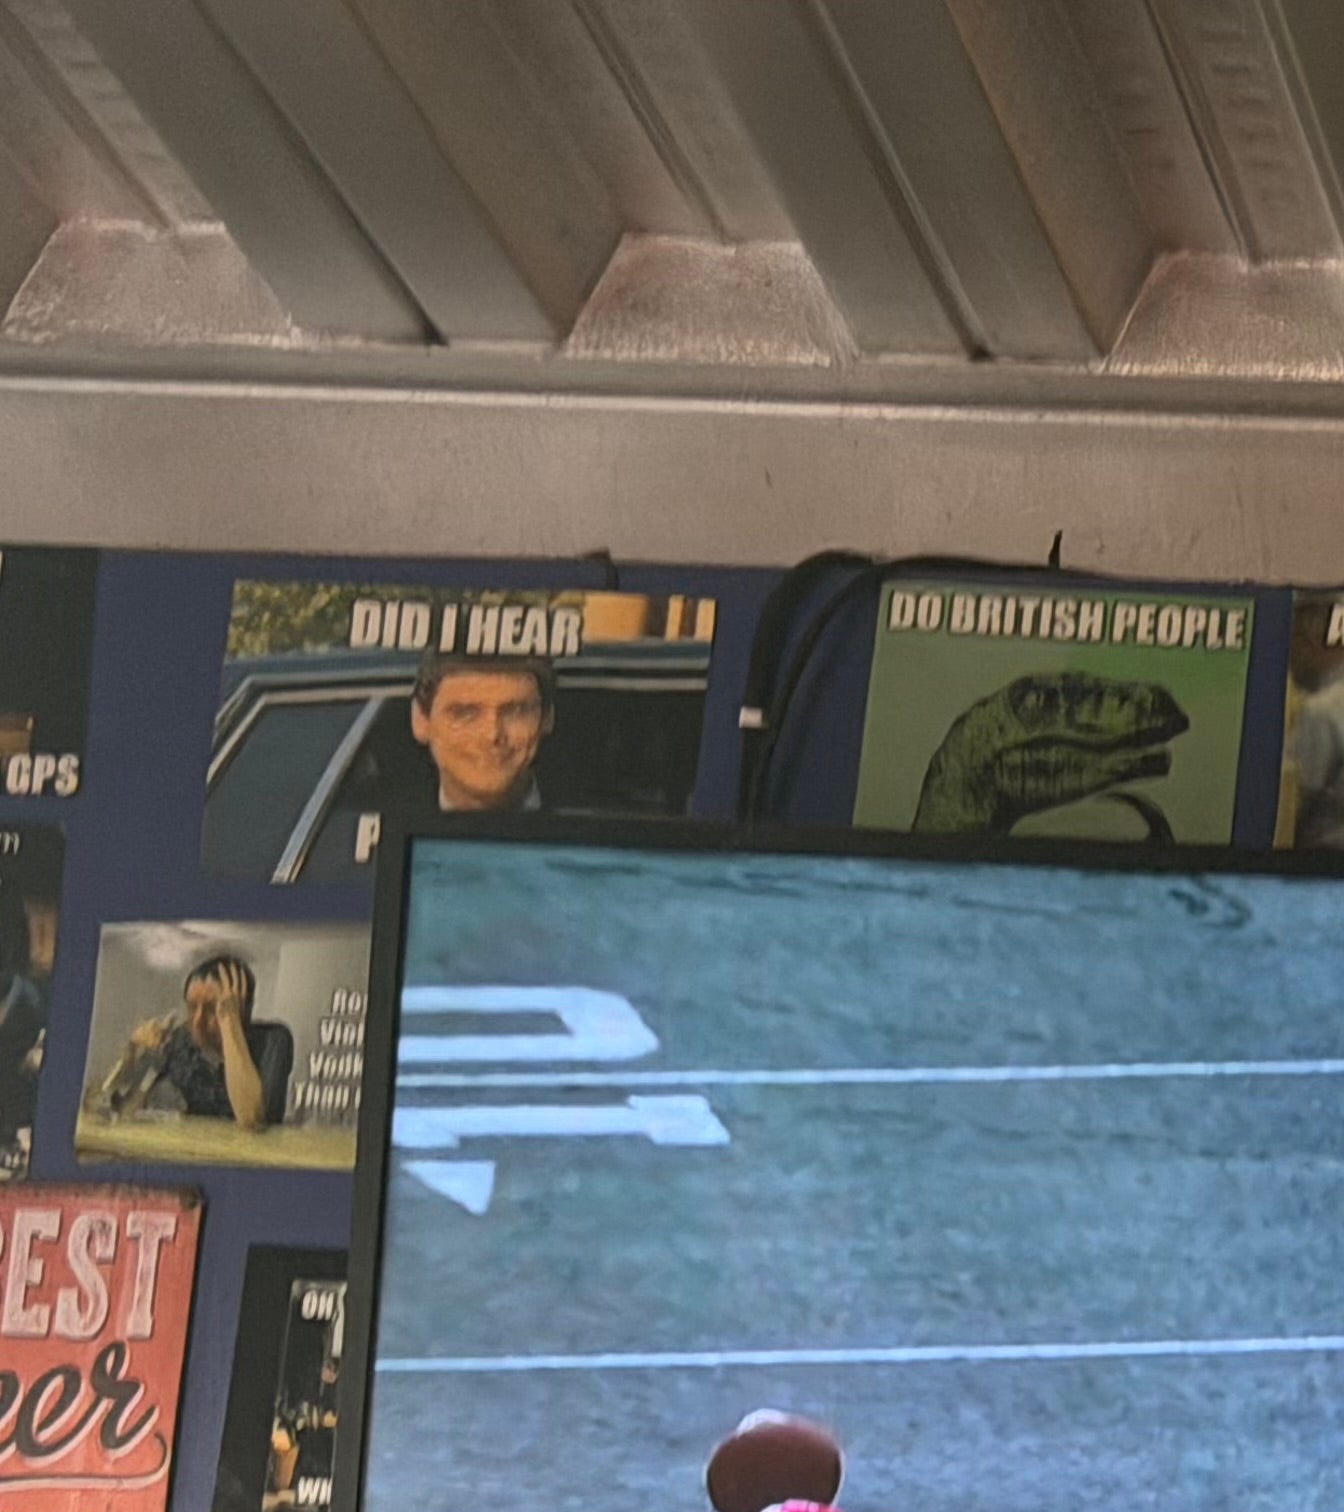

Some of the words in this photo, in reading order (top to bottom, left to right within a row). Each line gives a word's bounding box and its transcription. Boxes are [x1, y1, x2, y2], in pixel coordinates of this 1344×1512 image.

[351, 599, 431, 648] DID
[440, 603, 458, 653] I
[467, 604, 581, 656] HEAR
[889, 590, 942, 632] DO
[950, 592, 1104, 642] BRITISH
[1112, 602, 1245, 650] PEOPLE
[6, 753, 80, 797] GPS
